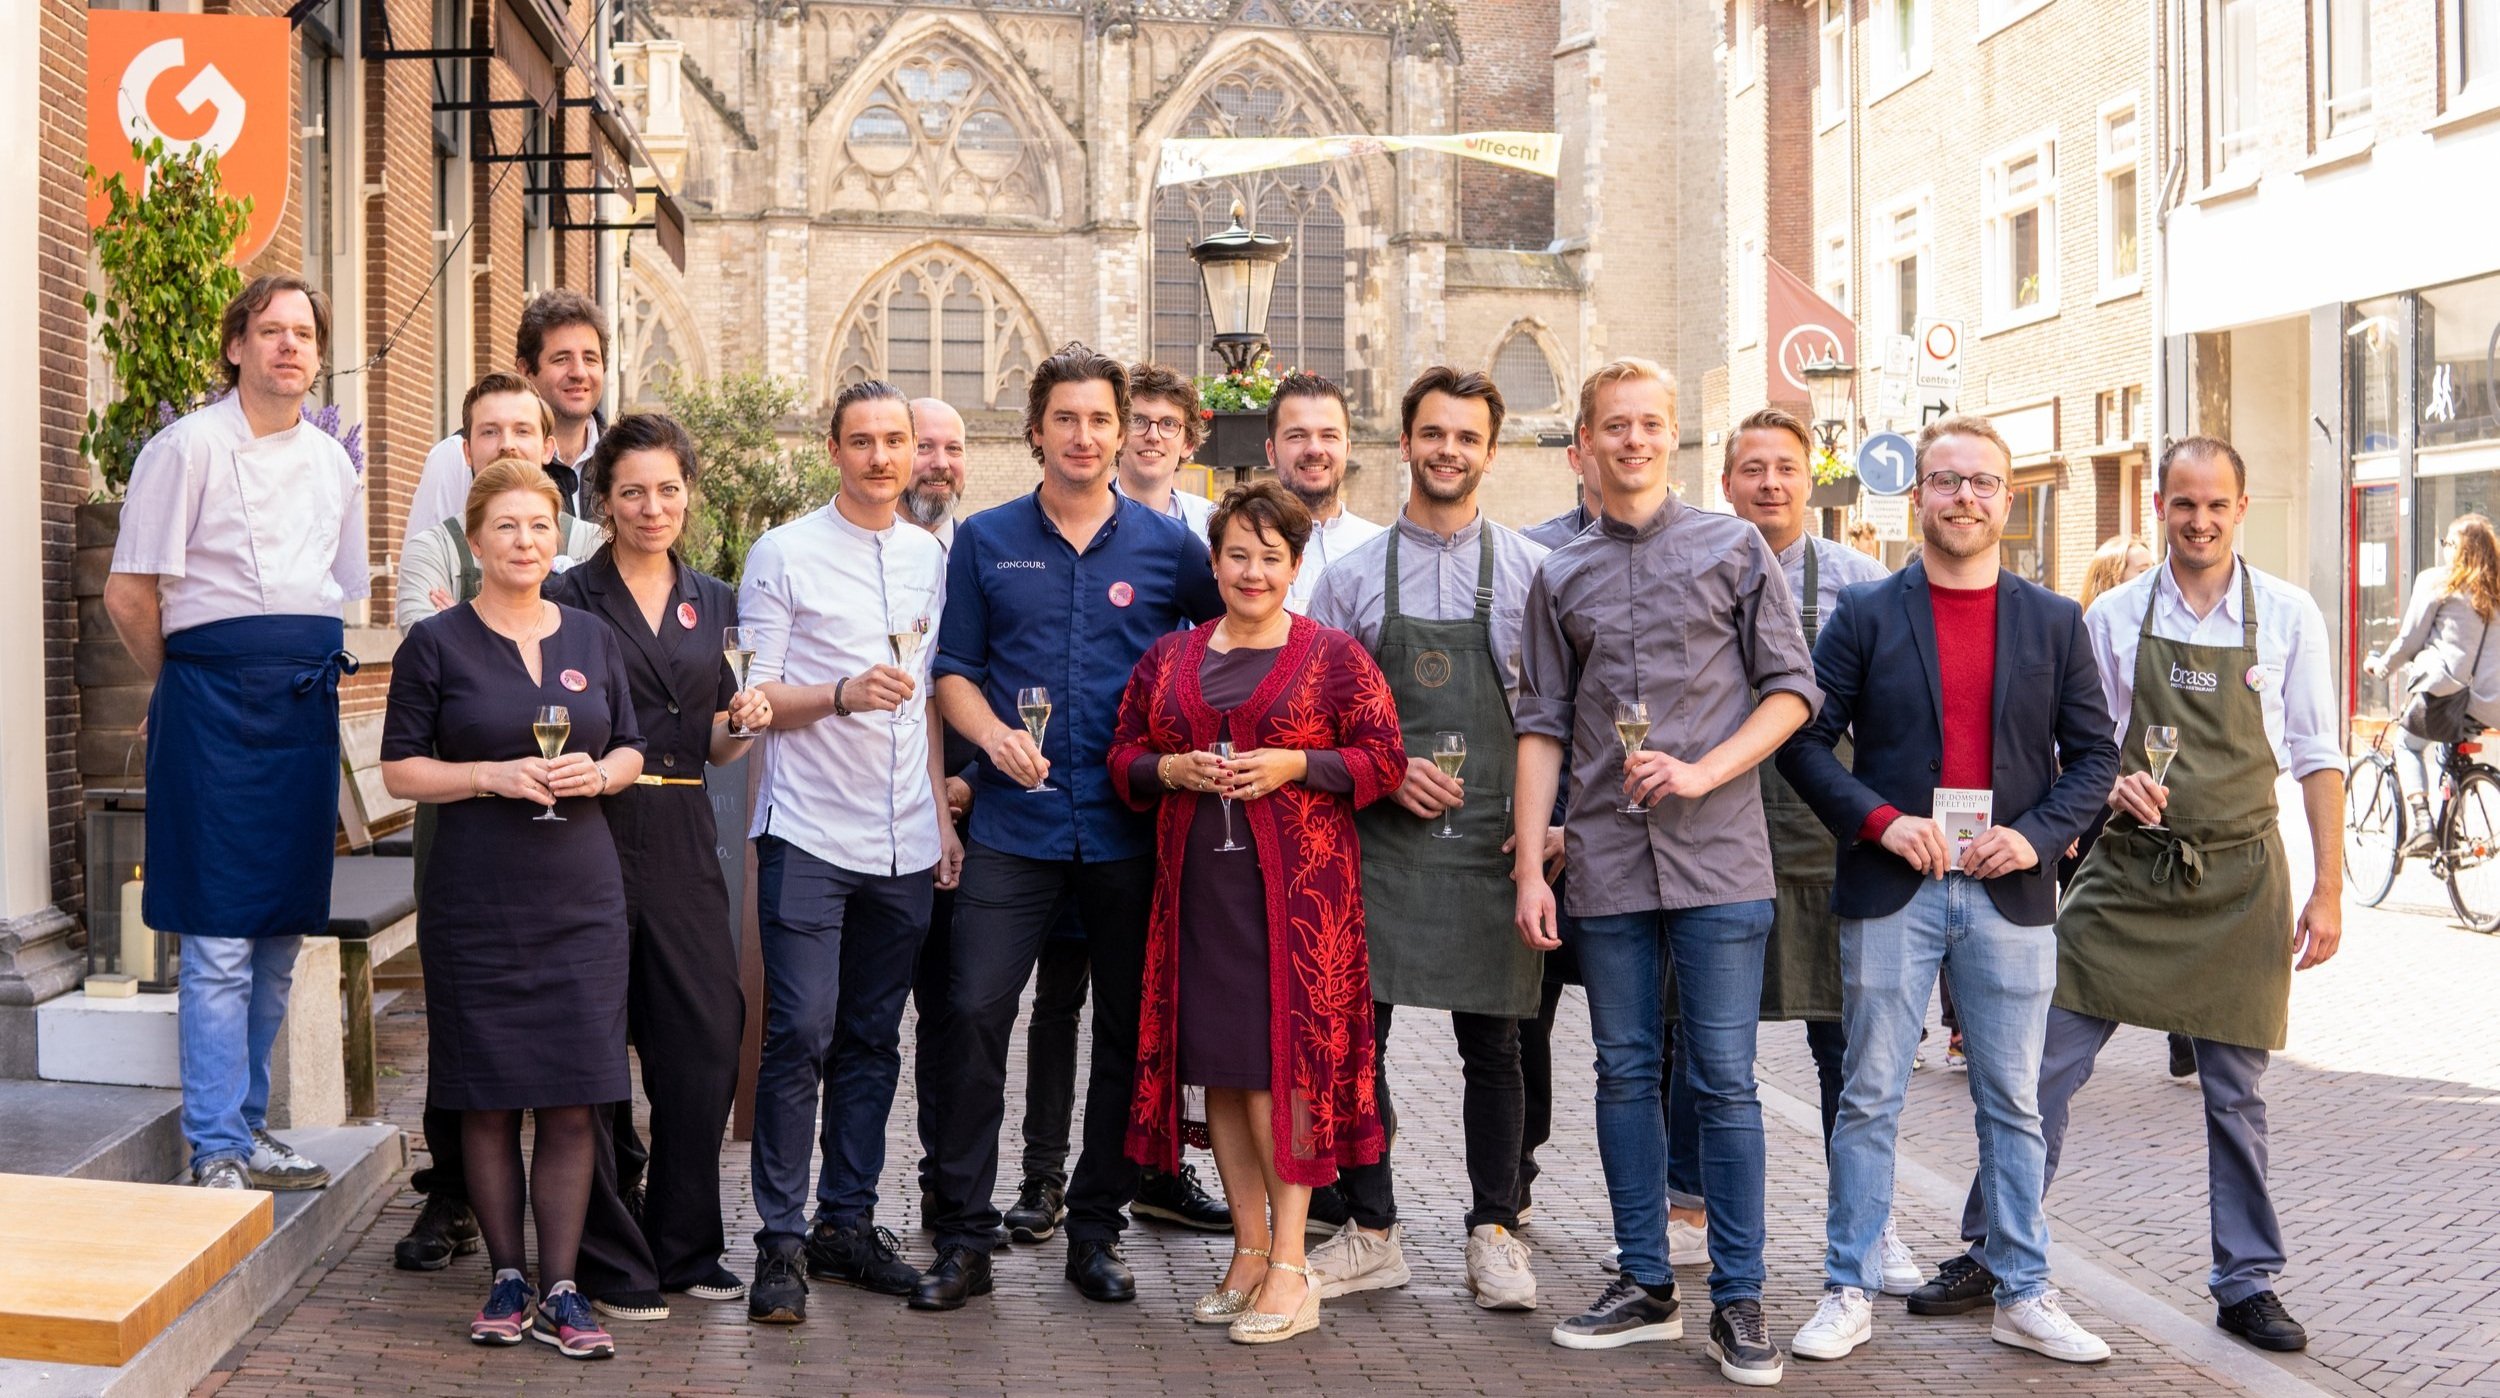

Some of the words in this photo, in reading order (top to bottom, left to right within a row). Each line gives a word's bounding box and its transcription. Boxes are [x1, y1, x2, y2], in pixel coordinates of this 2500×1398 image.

[996, 560, 1046, 570] CONCOURS
[2170, 662, 2217, 687] brass
[1935, 793, 1947, 801] DE
[1949, 794, 1990, 802] DOMSTAD
